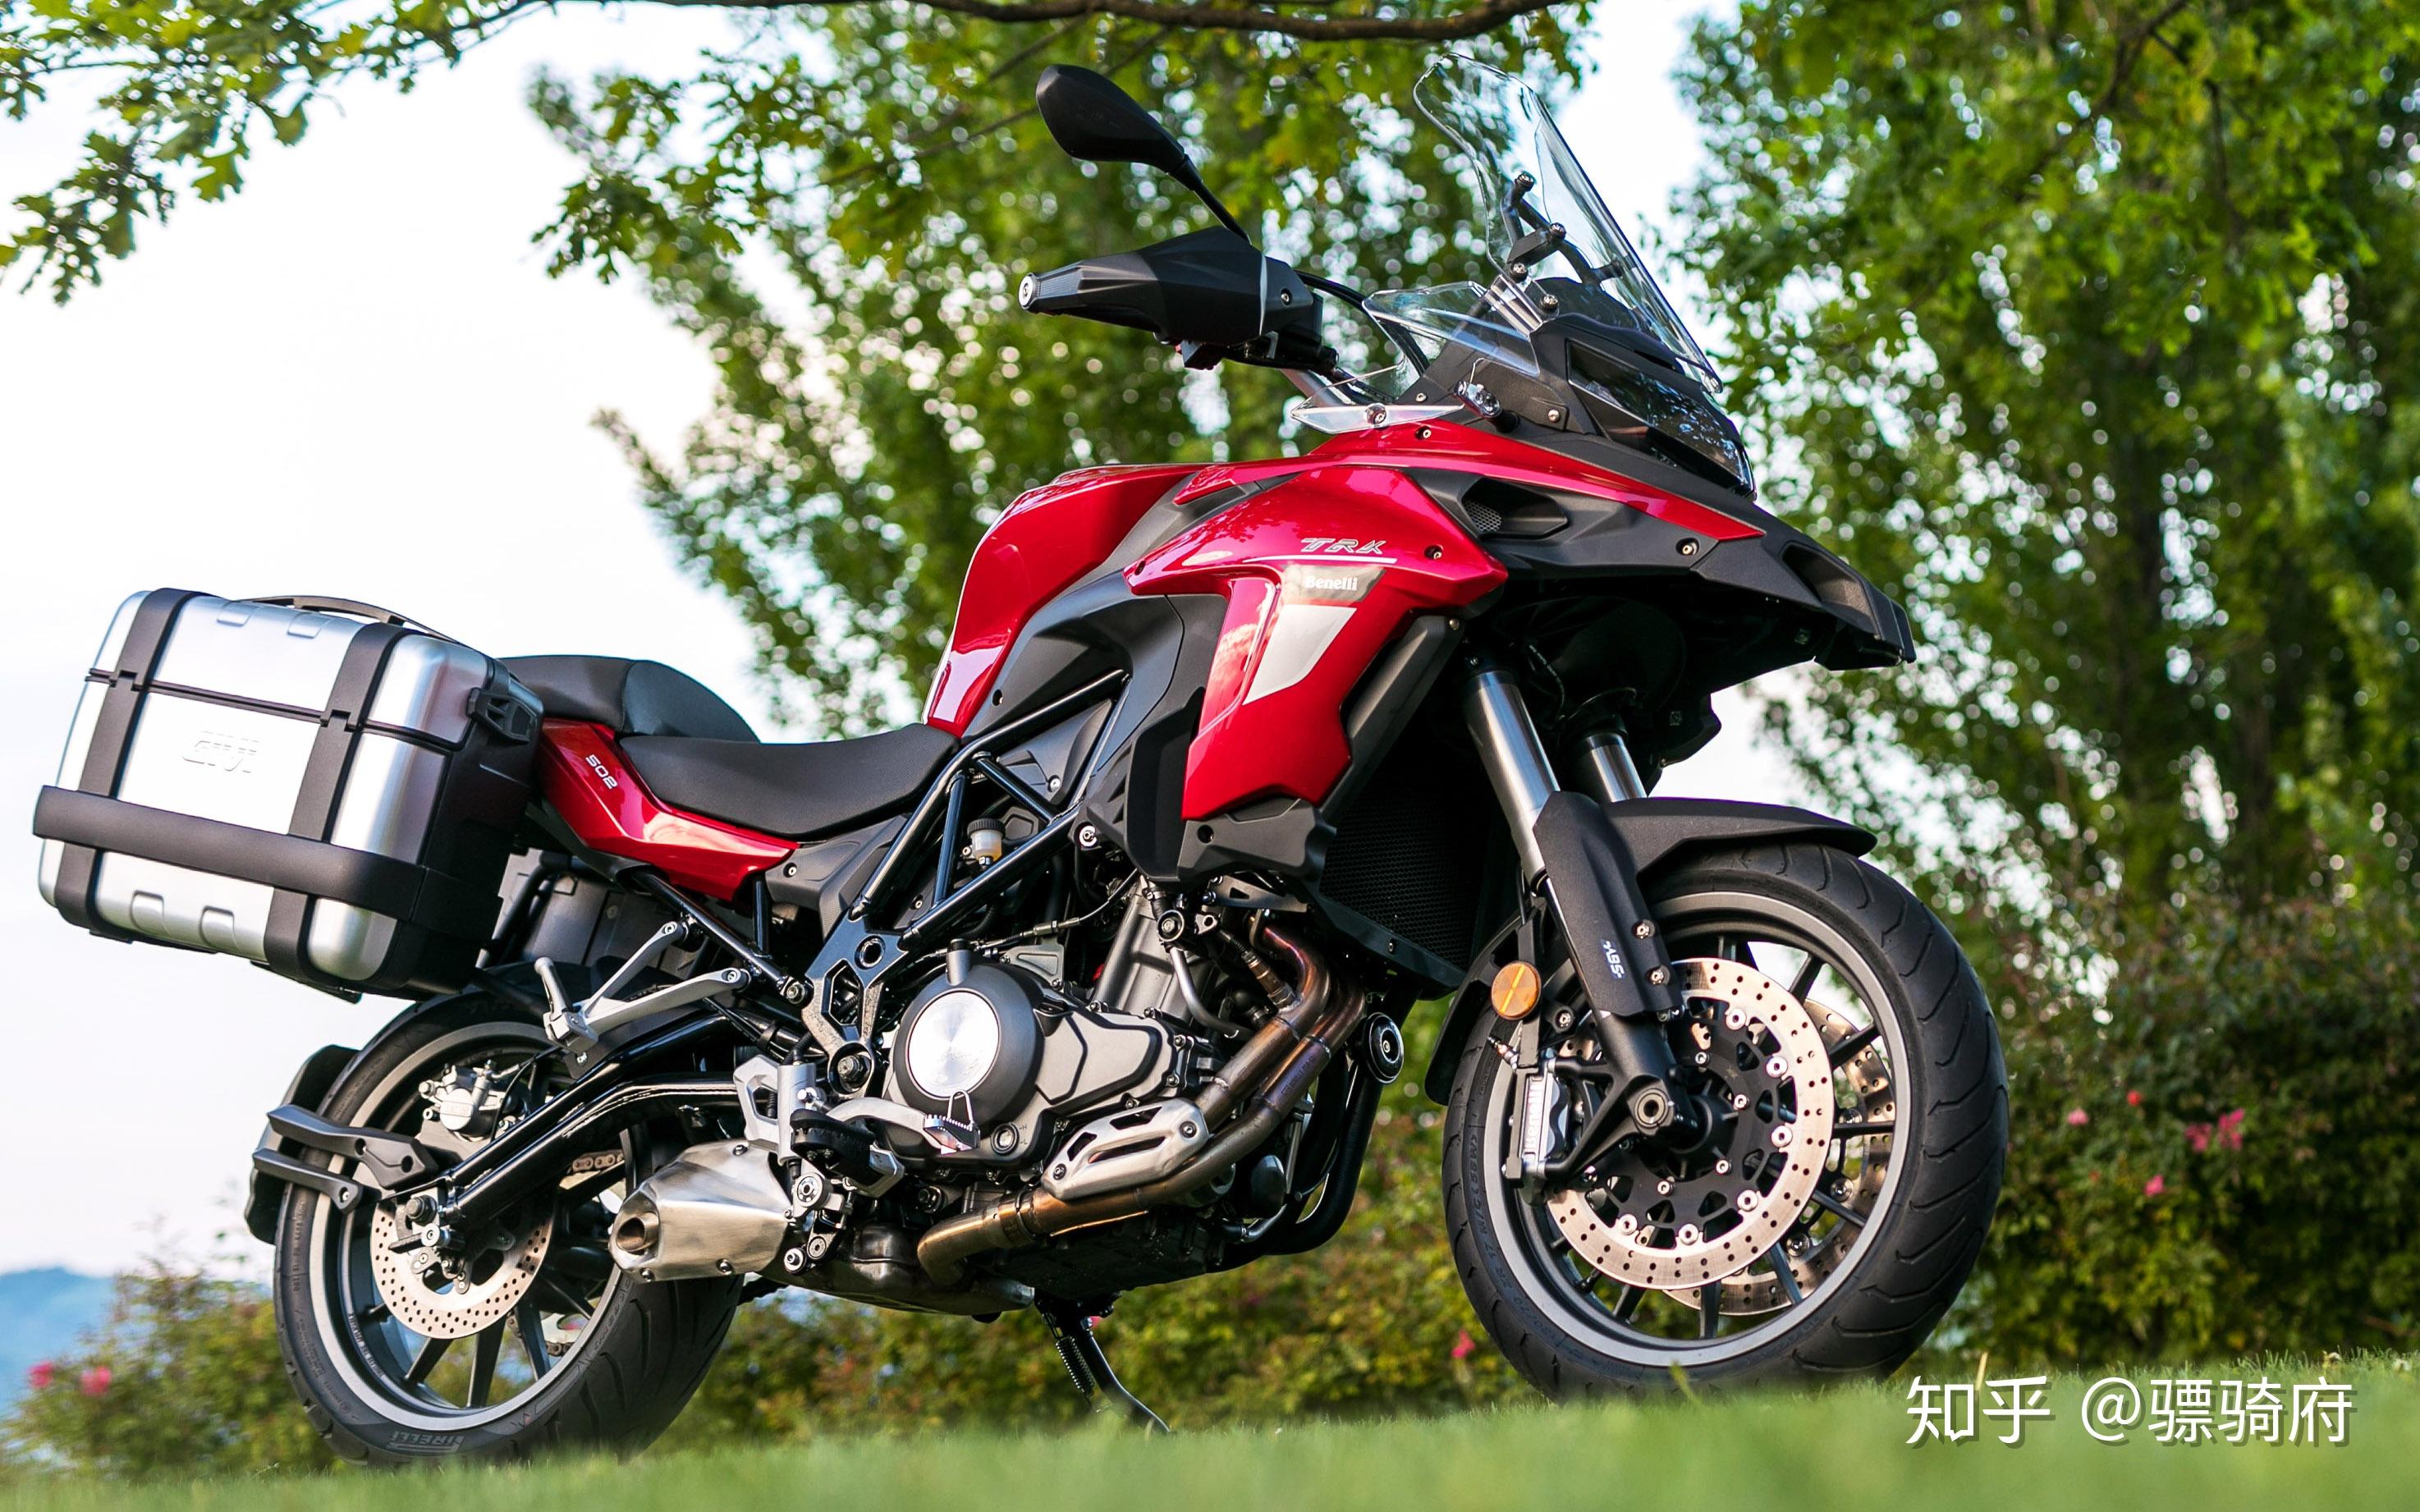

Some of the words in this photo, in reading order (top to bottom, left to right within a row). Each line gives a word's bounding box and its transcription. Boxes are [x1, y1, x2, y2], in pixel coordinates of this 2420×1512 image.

[1300, 538, 1386, 555] TRK
[1305, 576, 1358, 592] Benelli
[585, 754, 617, 790] 502
[1604, 943, 1625, 977] ABS
[1524, 1084, 1543, 1148] Benelli
[387, 1431, 465, 1453] PIRELLI
